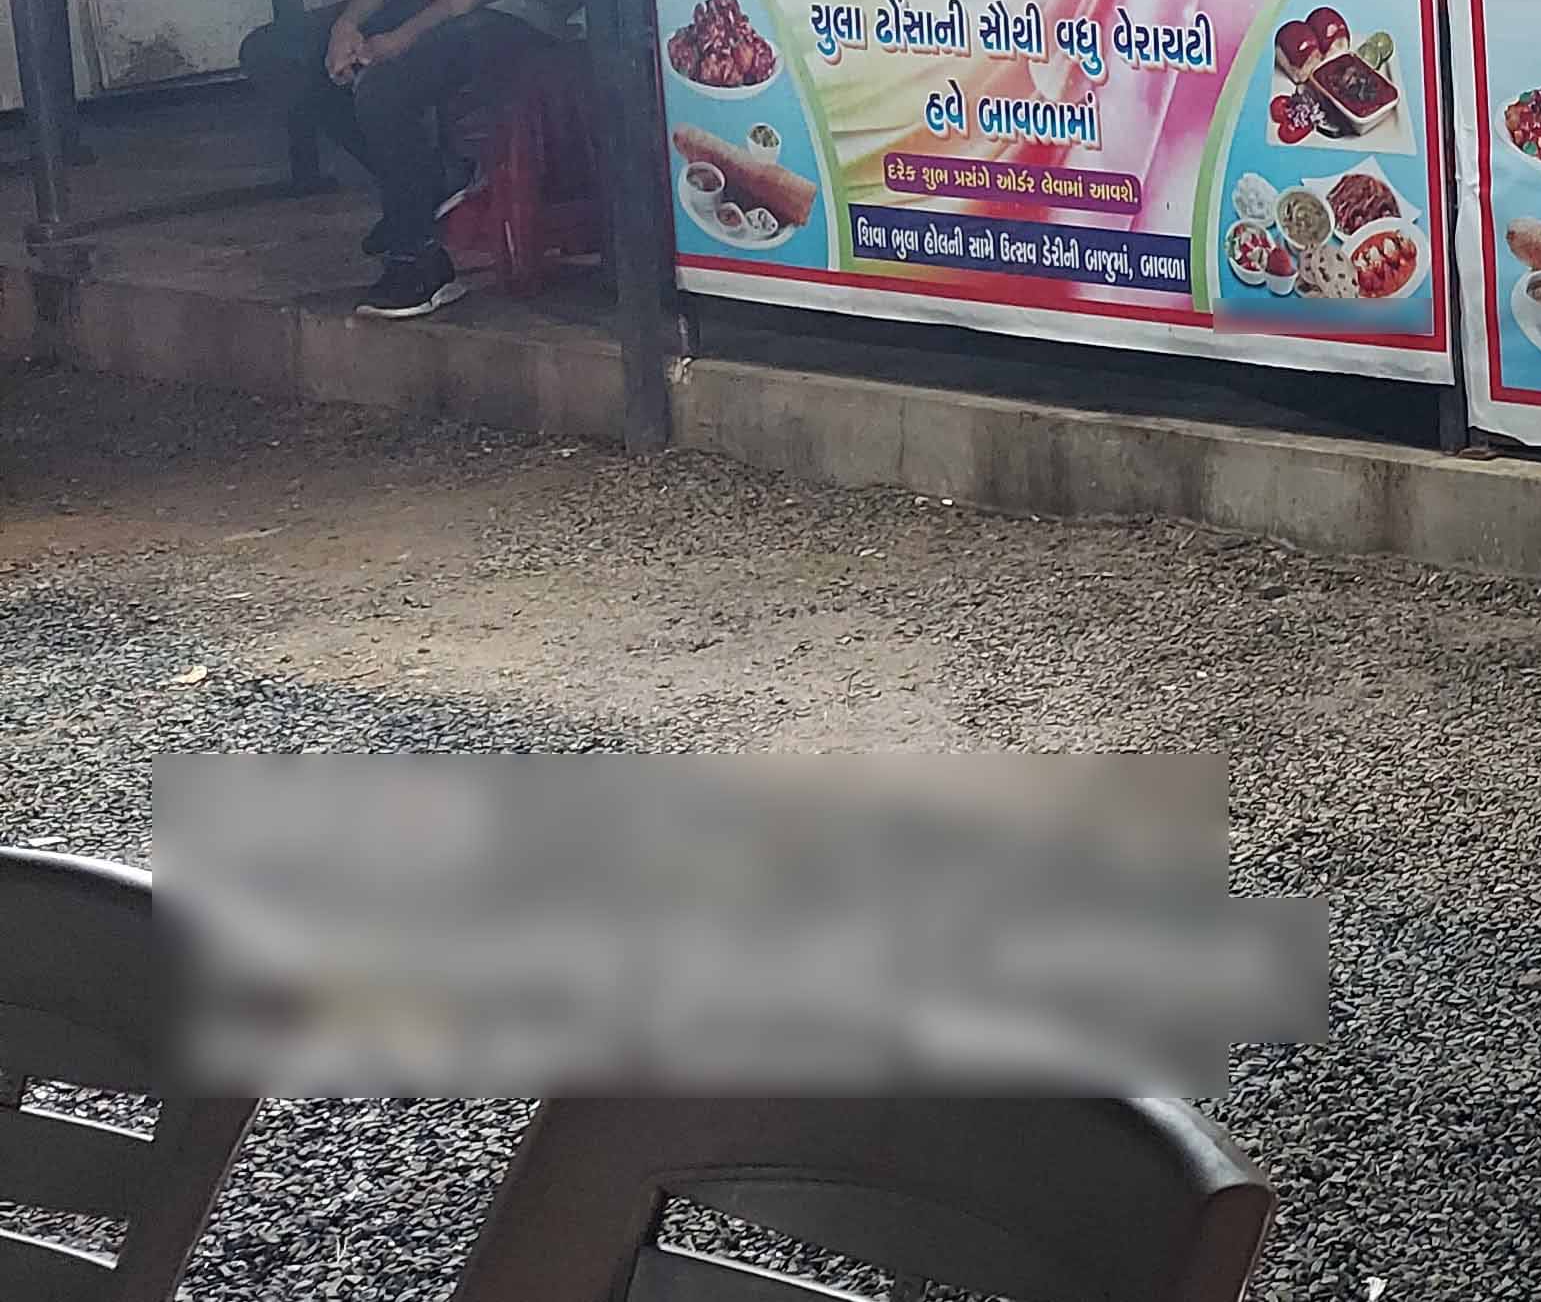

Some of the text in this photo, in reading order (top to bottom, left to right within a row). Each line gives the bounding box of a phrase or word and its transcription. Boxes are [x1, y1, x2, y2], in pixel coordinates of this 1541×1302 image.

[979, 0, 1043, 55] સૌથી
[1055, 17, 1104, 76] વધુ
[1113, 7, 1213, 67] વેરાયટી
[925, 78, 1096, 141] હવે બાવળામાં
[887, 158, 917, 182] દરેક
[922, 167, 949, 191] શુભ
[954, 166, 991, 189] પ્રસંગે
[996, 168, 1036, 194] ઓર્ડર
[1041, 171, 1084, 198] લેવામાં
[857, 216, 887, 249] શિવા
[924, 224, 964, 257] હોલની
[968, 228, 995, 260] સામે
[1000, 232, 1037, 265] ઉત્સવ
[1042, 234, 1080, 270] ડેરીની
[1140, 254, 1187, 282] બાવળા
